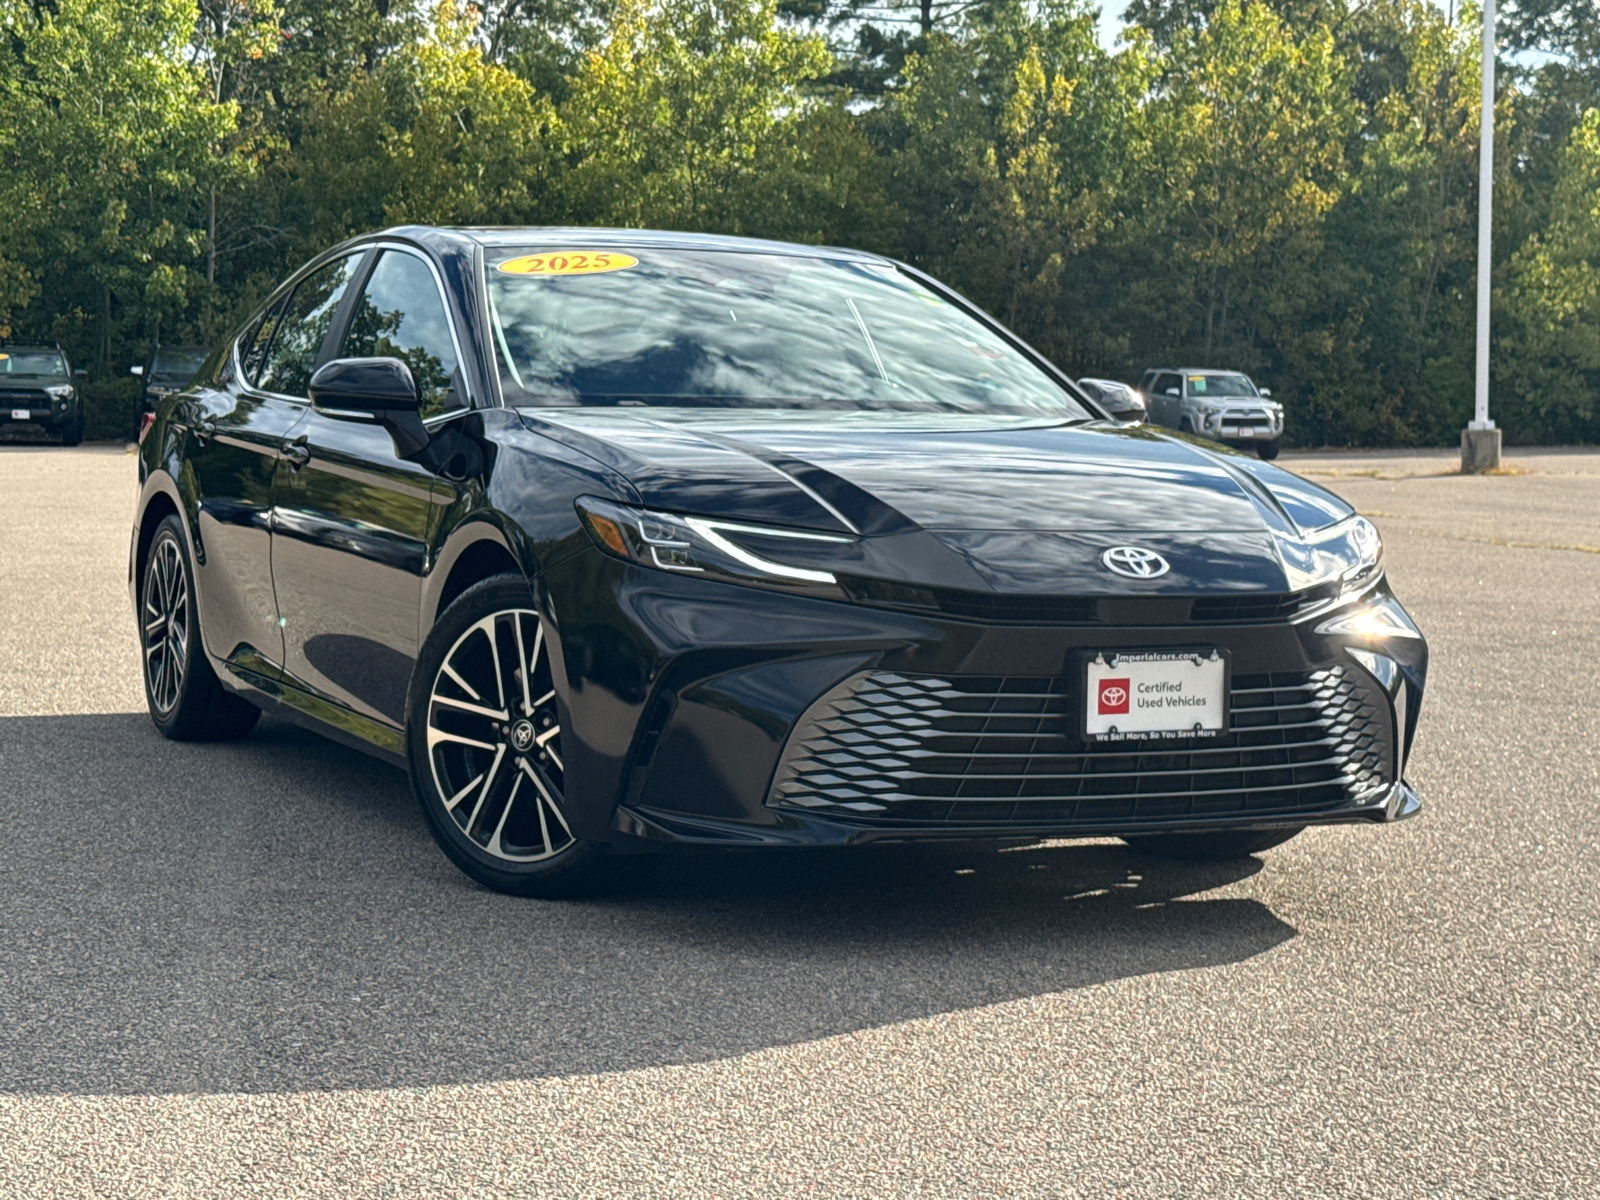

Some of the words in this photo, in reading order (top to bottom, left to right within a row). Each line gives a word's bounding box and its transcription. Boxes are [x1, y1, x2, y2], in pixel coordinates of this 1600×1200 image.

[526, 254, 611, 273] 2025
[1137, 681, 1182, 693] Certified
[1137, 696, 1163, 708] Used
[1165, 695, 1207, 707] Vehicles
[1096, 733, 1109, 742] We
[1110, 732, 1125, 741] Sell
[1126, 732, 1148, 741] More,
[1150, 731, 1161, 740] So
[1162, 731, 1176, 739] You
[1177, 730, 1196, 739] Save
[1197, 729, 1216, 738] More
